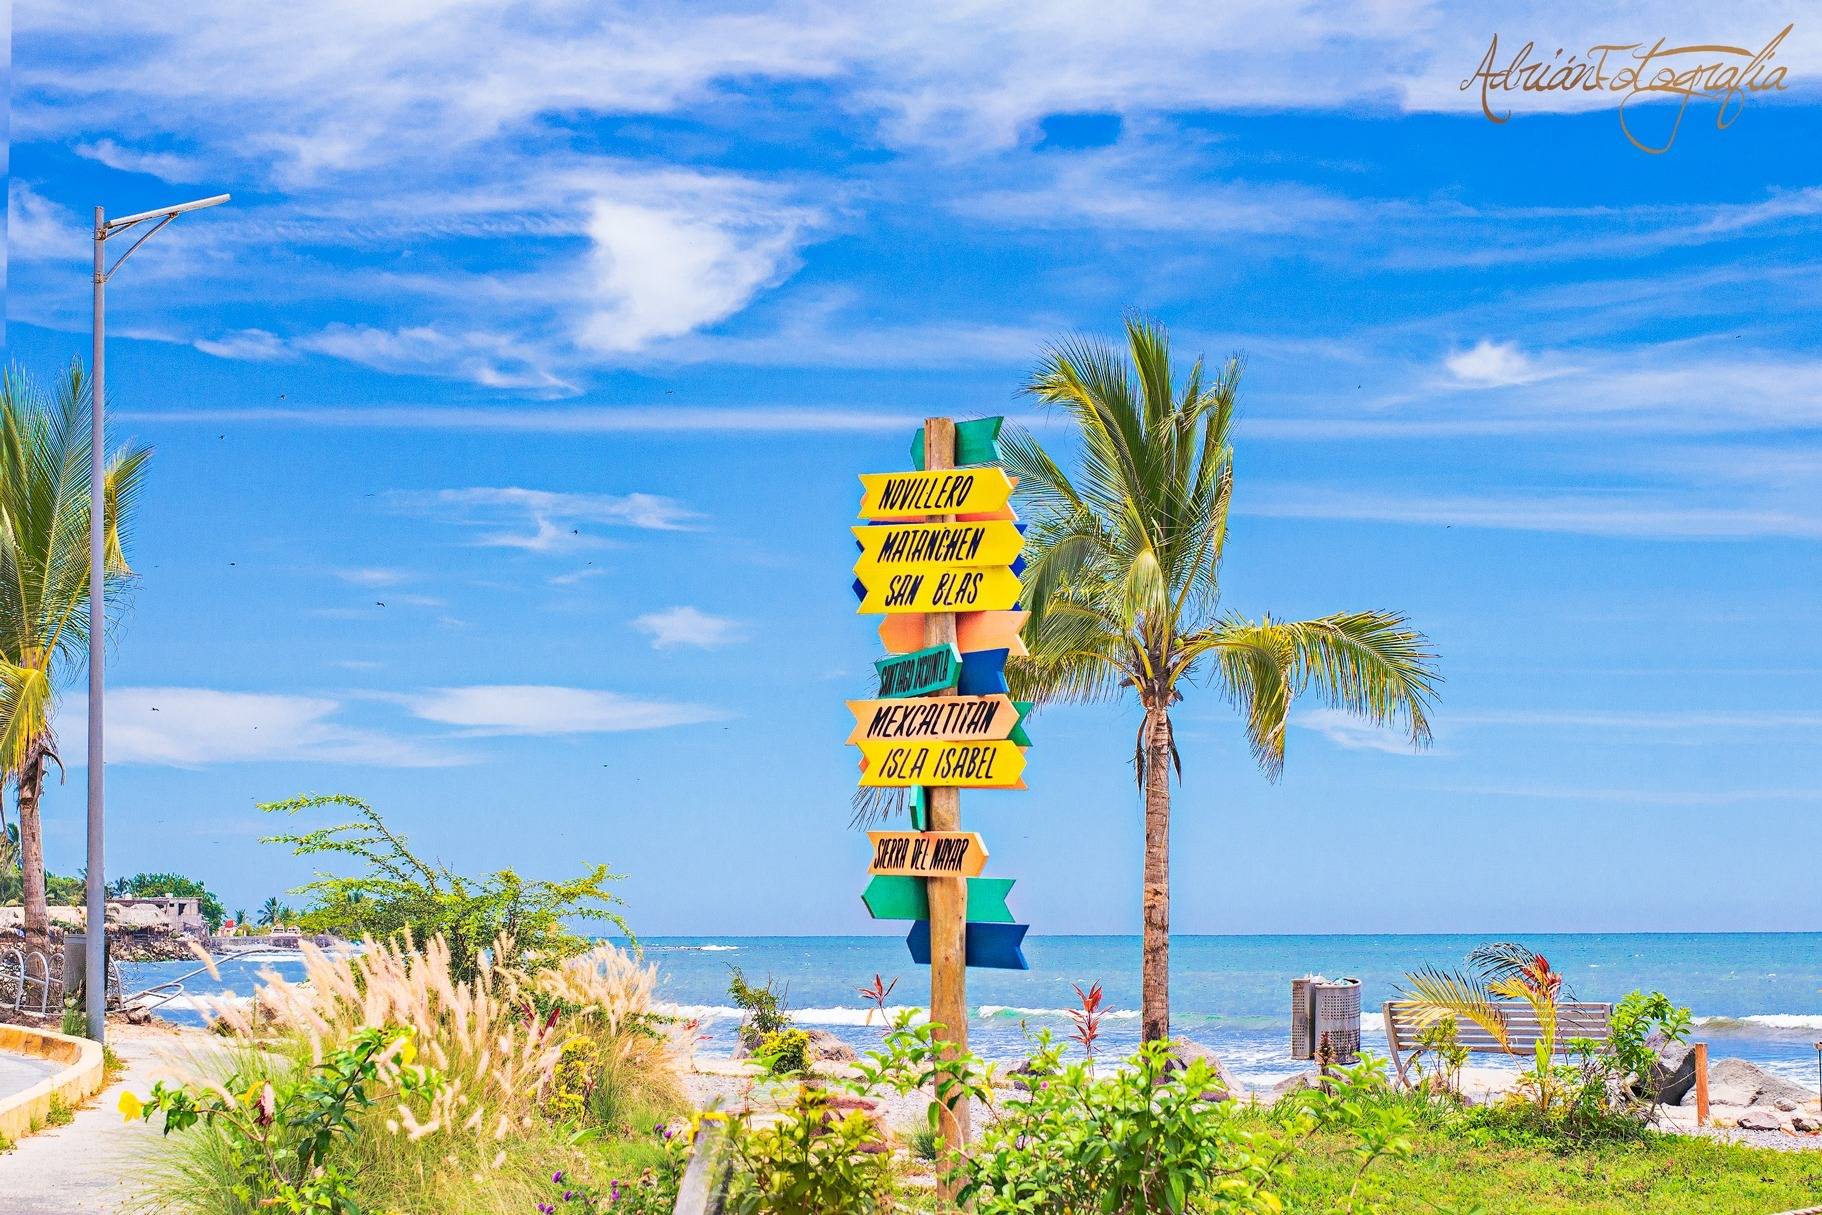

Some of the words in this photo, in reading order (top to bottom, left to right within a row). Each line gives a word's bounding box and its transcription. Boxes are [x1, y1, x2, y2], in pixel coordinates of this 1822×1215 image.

[878, 475, 974, 510] NOVILLERO
[877, 527, 985, 564] MATANCHEN
[884, 574, 925, 607] SAN
[932, 572, 984, 606] BLAS
[866, 700, 1001, 739] MEXCALTITAN
[878, 747, 930, 779] ISLA
[933, 746, 997, 779] ISABEL
[873, 838, 910, 869] SIERRA
[910, 838, 930, 870] DEL
[929, 838, 970, 872] NAYAR
